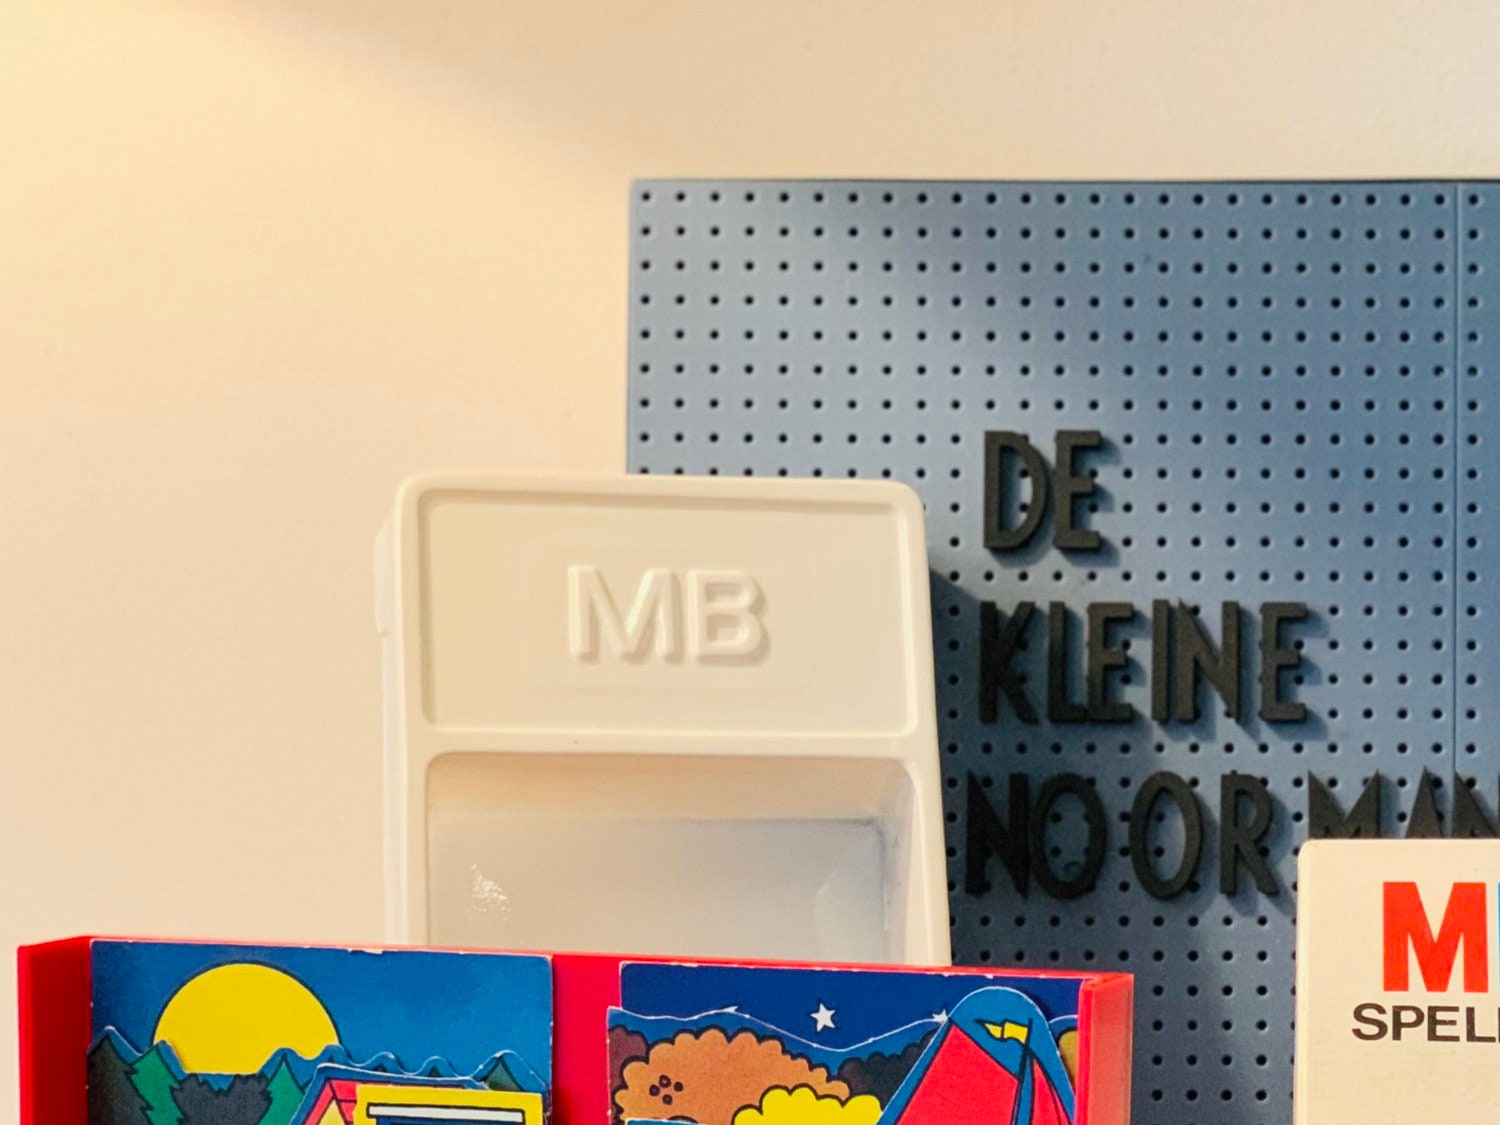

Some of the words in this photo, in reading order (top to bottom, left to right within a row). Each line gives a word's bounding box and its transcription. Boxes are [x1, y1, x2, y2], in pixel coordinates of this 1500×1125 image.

[983, 430, 1100, 549] DE
[566, 564, 765, 659] MB
[978, 598, 1308, 724] KLEINE
